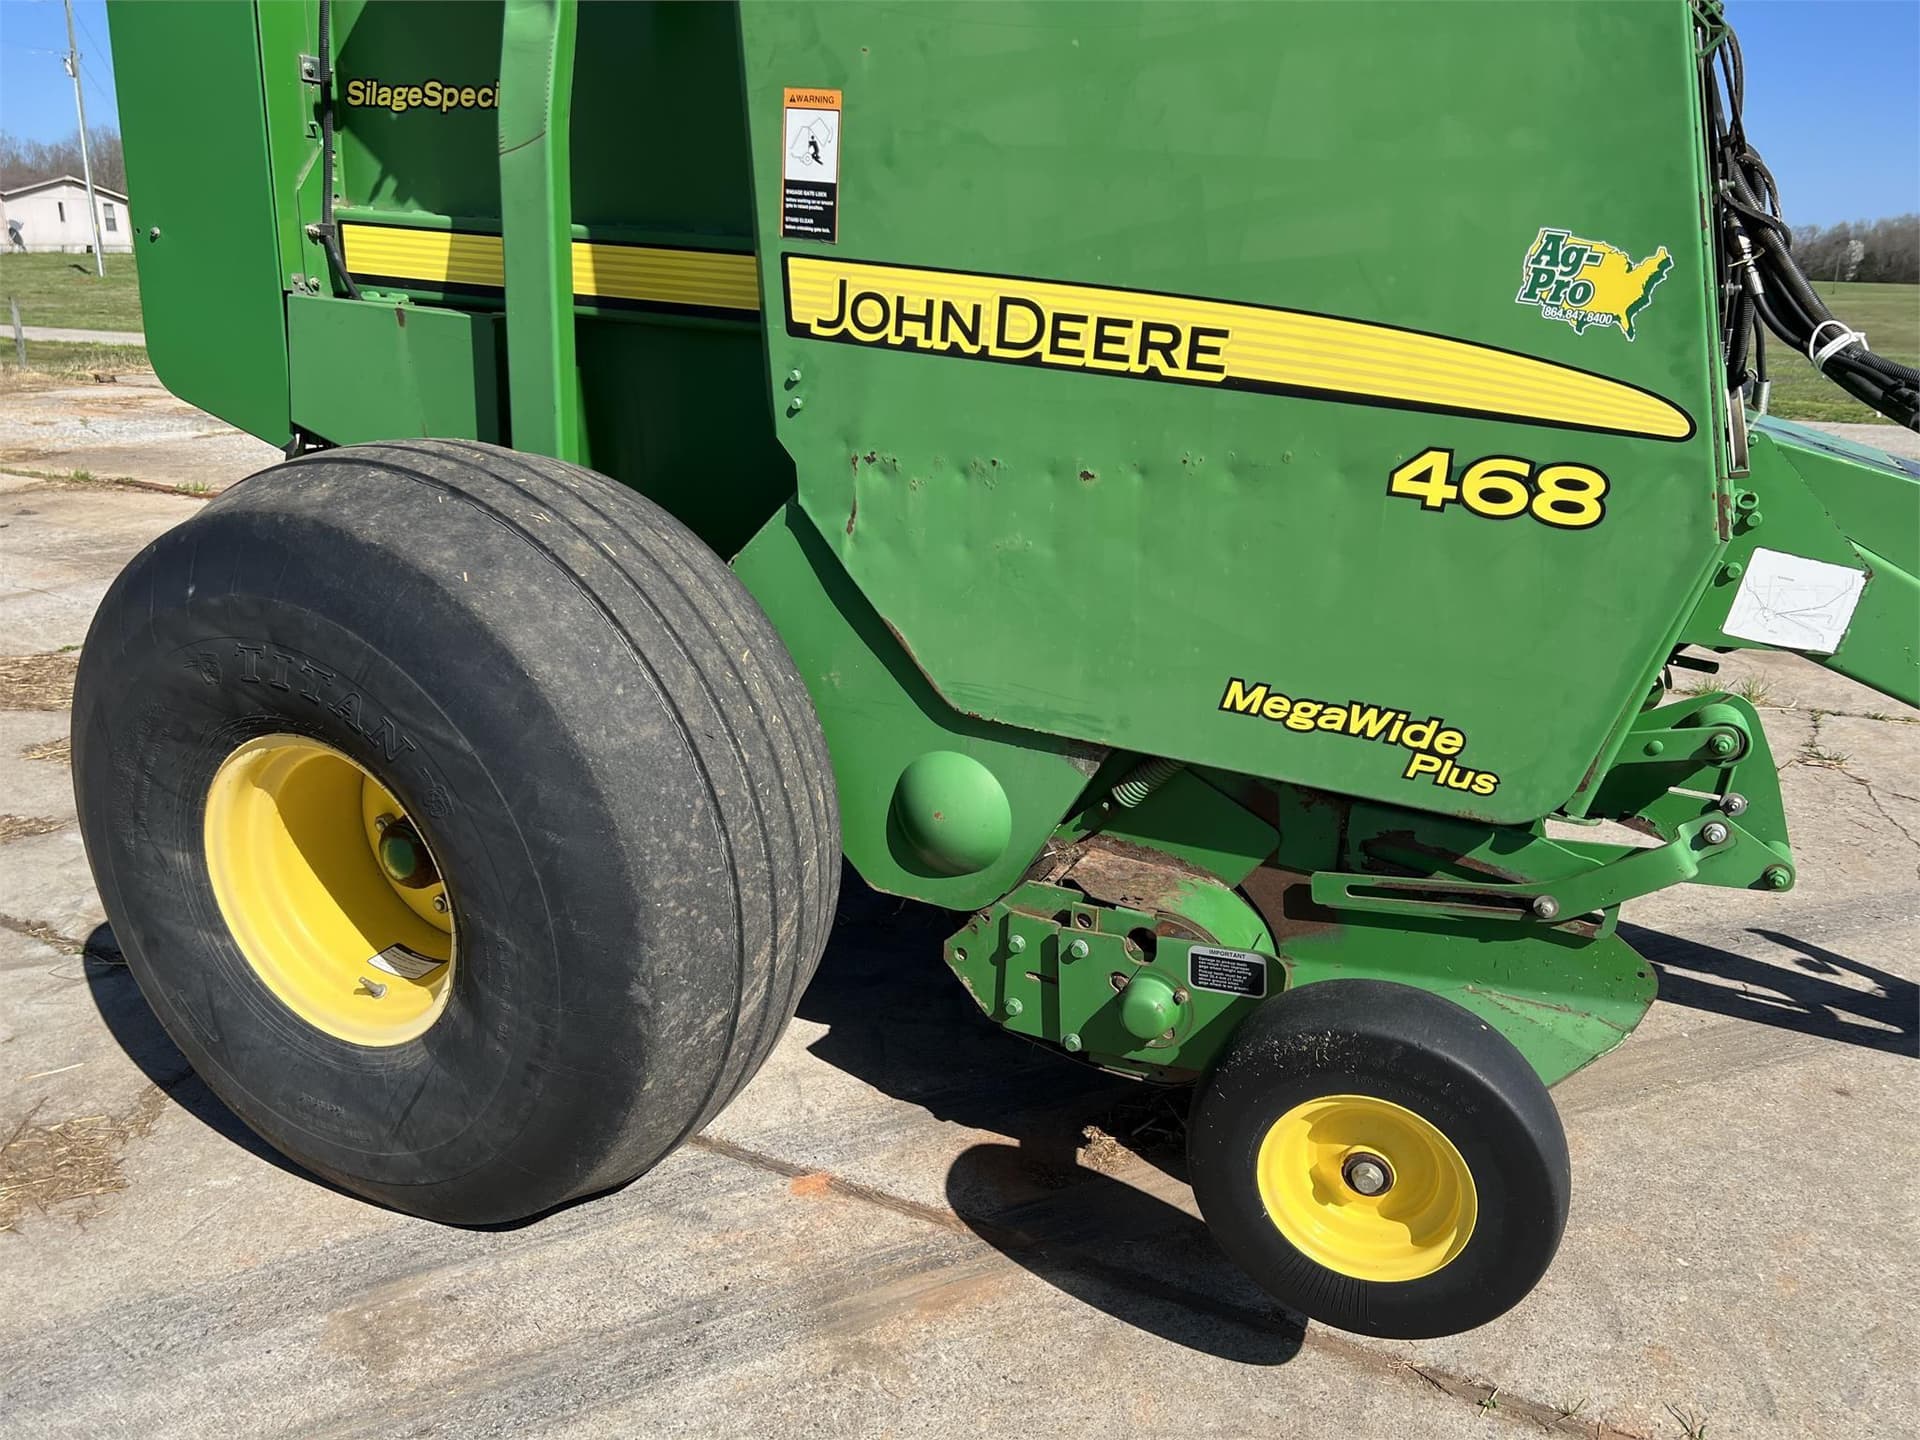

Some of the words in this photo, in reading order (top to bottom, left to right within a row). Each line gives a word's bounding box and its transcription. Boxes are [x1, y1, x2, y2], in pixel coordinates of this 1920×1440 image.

[796, 95, 834, 104] WARNING
[1531, 231, 1604, 277] Ag-
[1518, 267, 1595, 307] Pro
[816, 279, 982, 347] JOHN
[996, 295, 1230, 374] DEERE
[1543, 306, 1614, 326] 864.847.8400
[1389, 448, 1608, 528] 468
[234, 642, 416, 762] TITAN
[1219, 678, 1465, 756] MegaWide
[1403, 751, 1499, 796] Plus
[1209, 949, 1246, 959] IMPORTANT
